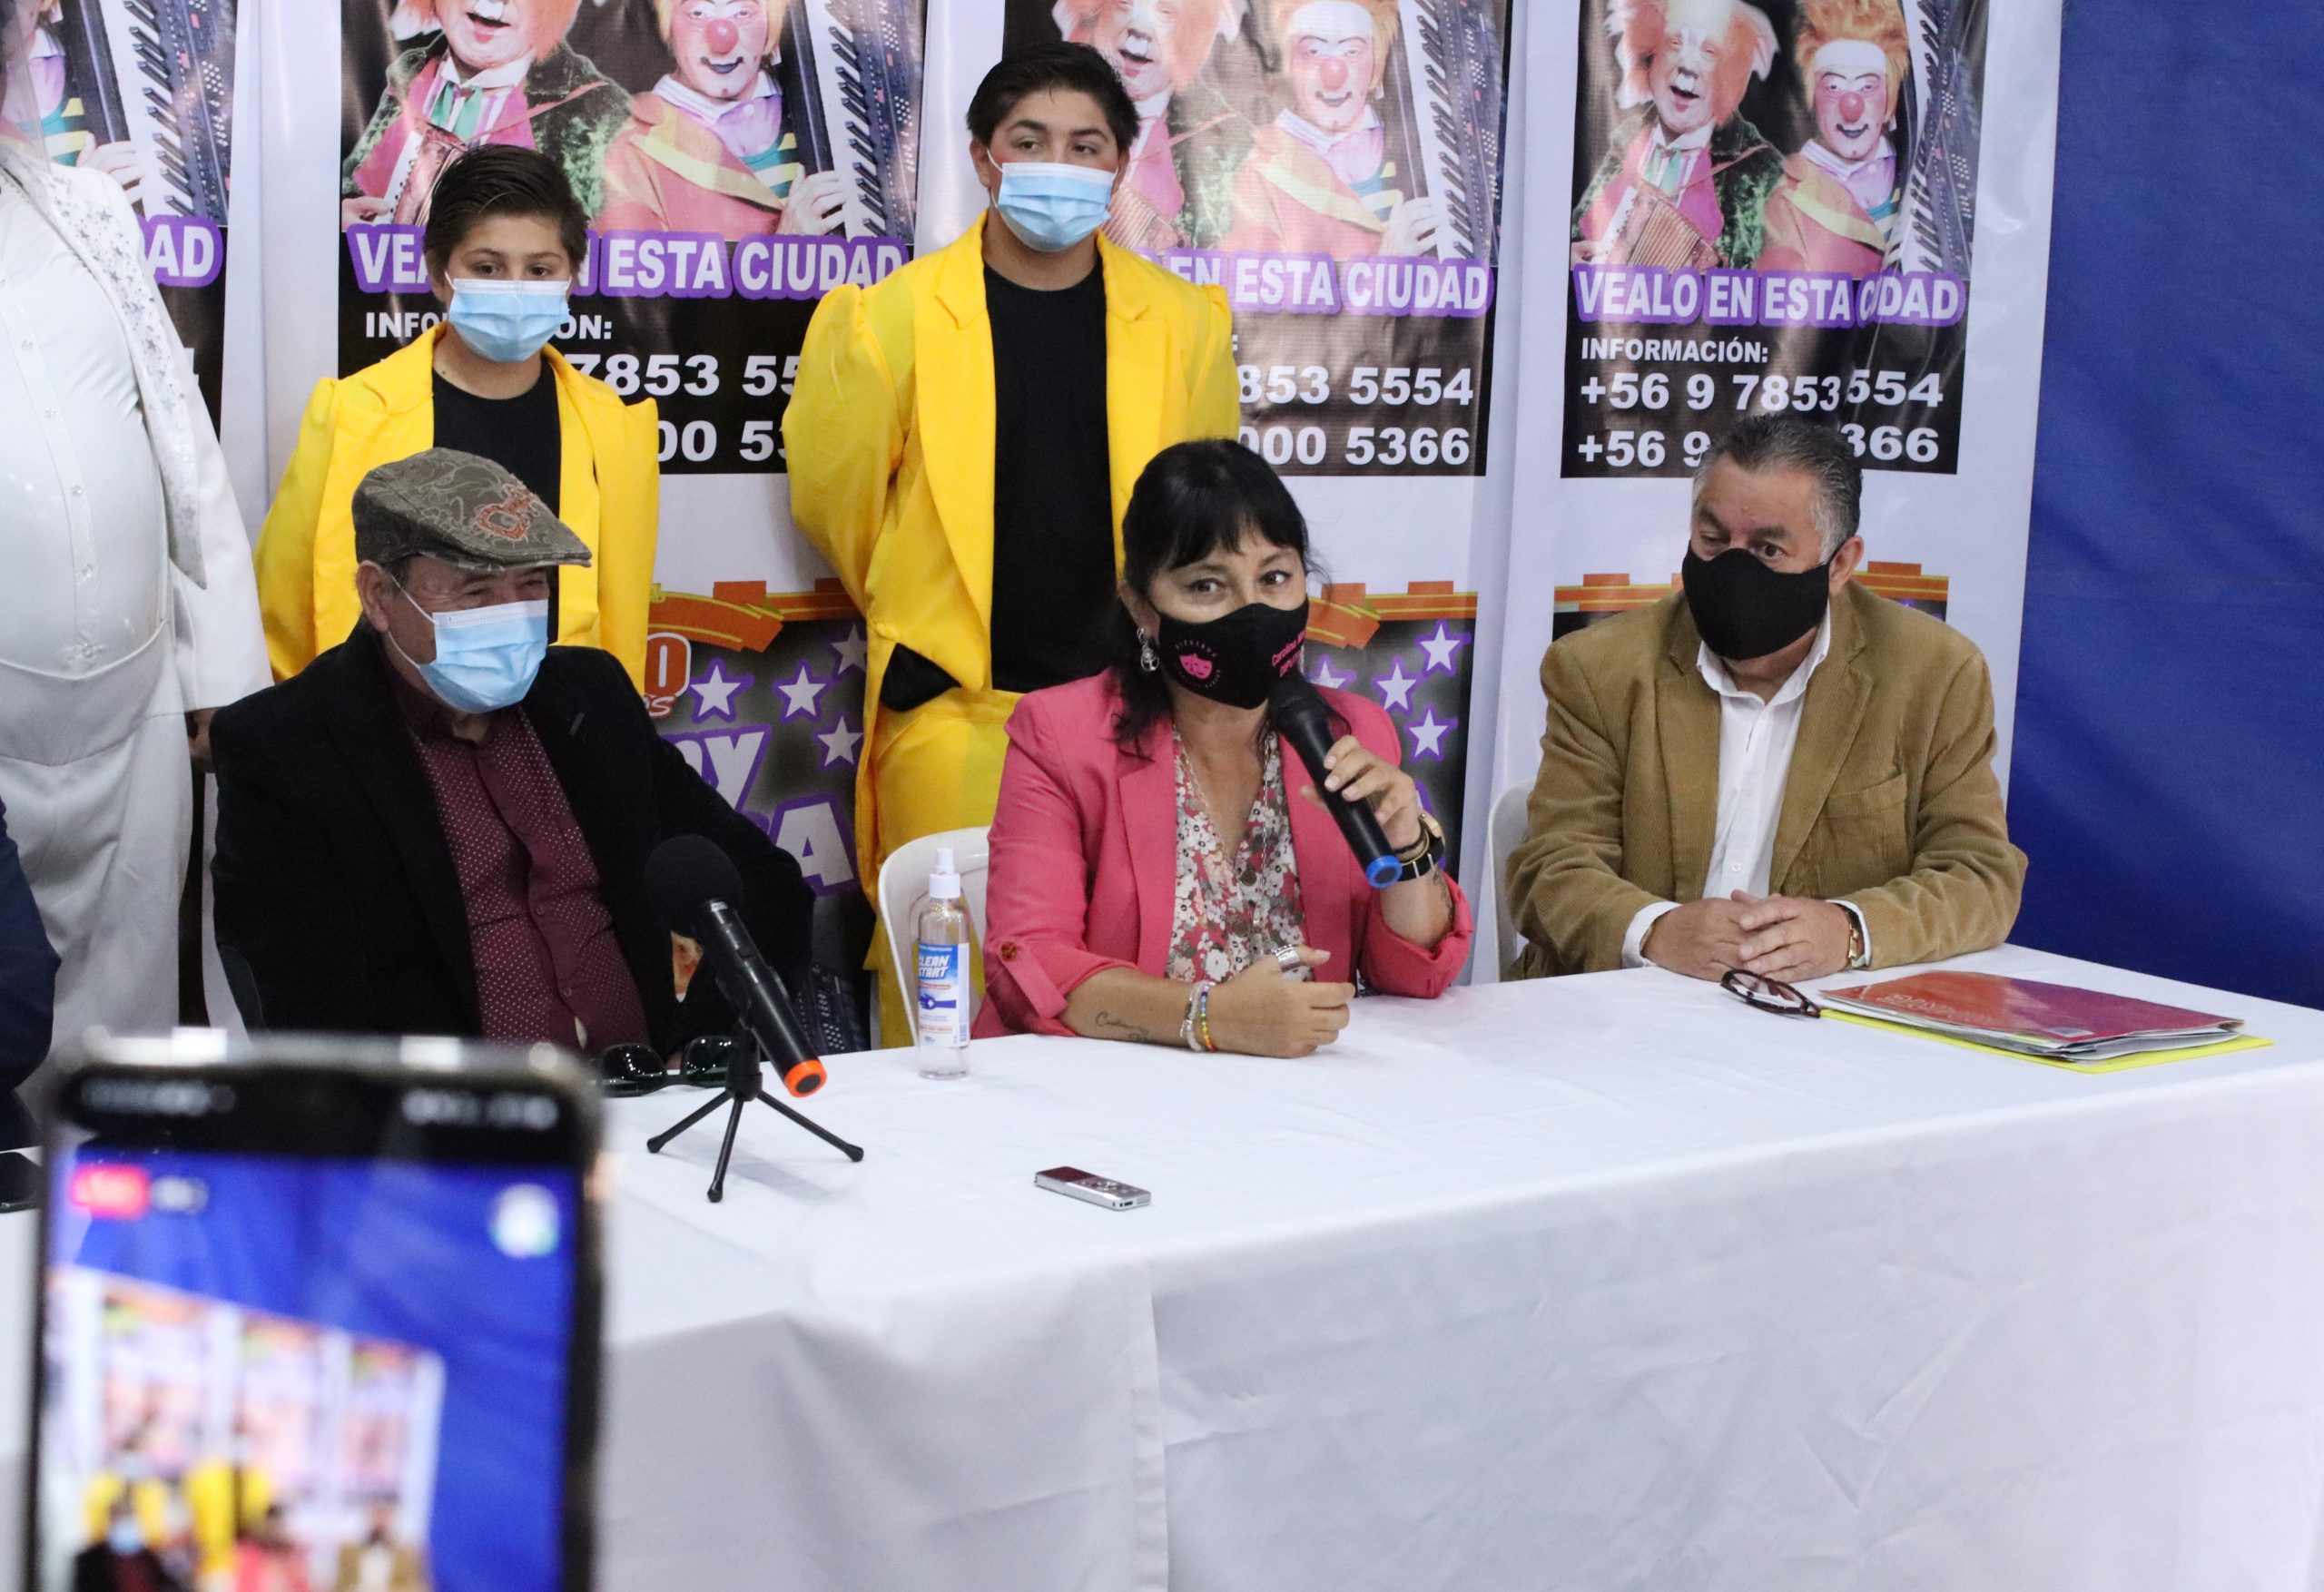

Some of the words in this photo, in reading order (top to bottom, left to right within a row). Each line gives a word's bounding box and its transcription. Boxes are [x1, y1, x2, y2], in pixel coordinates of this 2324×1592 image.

[608, 239, 725, 290] ESTA
[1235, 259, 1334, 306] ESTA
[1346, 262, 1488, 310] CIUDAD
[1578, 270, 1699, 318] VEALO
[1709, 275, 1754, 319] EN
[1765, 277, 1851, 321] ESTA
[1581, 336, 1768, 363] INFORMACIÓN:
[1236, 365, 1330, 405] 853
[1349, 367, 1473, 406] 5554
[1581, 372, 1669, 409] +56
[1687, 373, 1715, 410] 9
[1732, 374, 1841, 412] 7853
[1345, 427, 1470, 466] 5366
[1578, 430, 1666, 467] +56
[1682, 431, 1711, 467] 9
